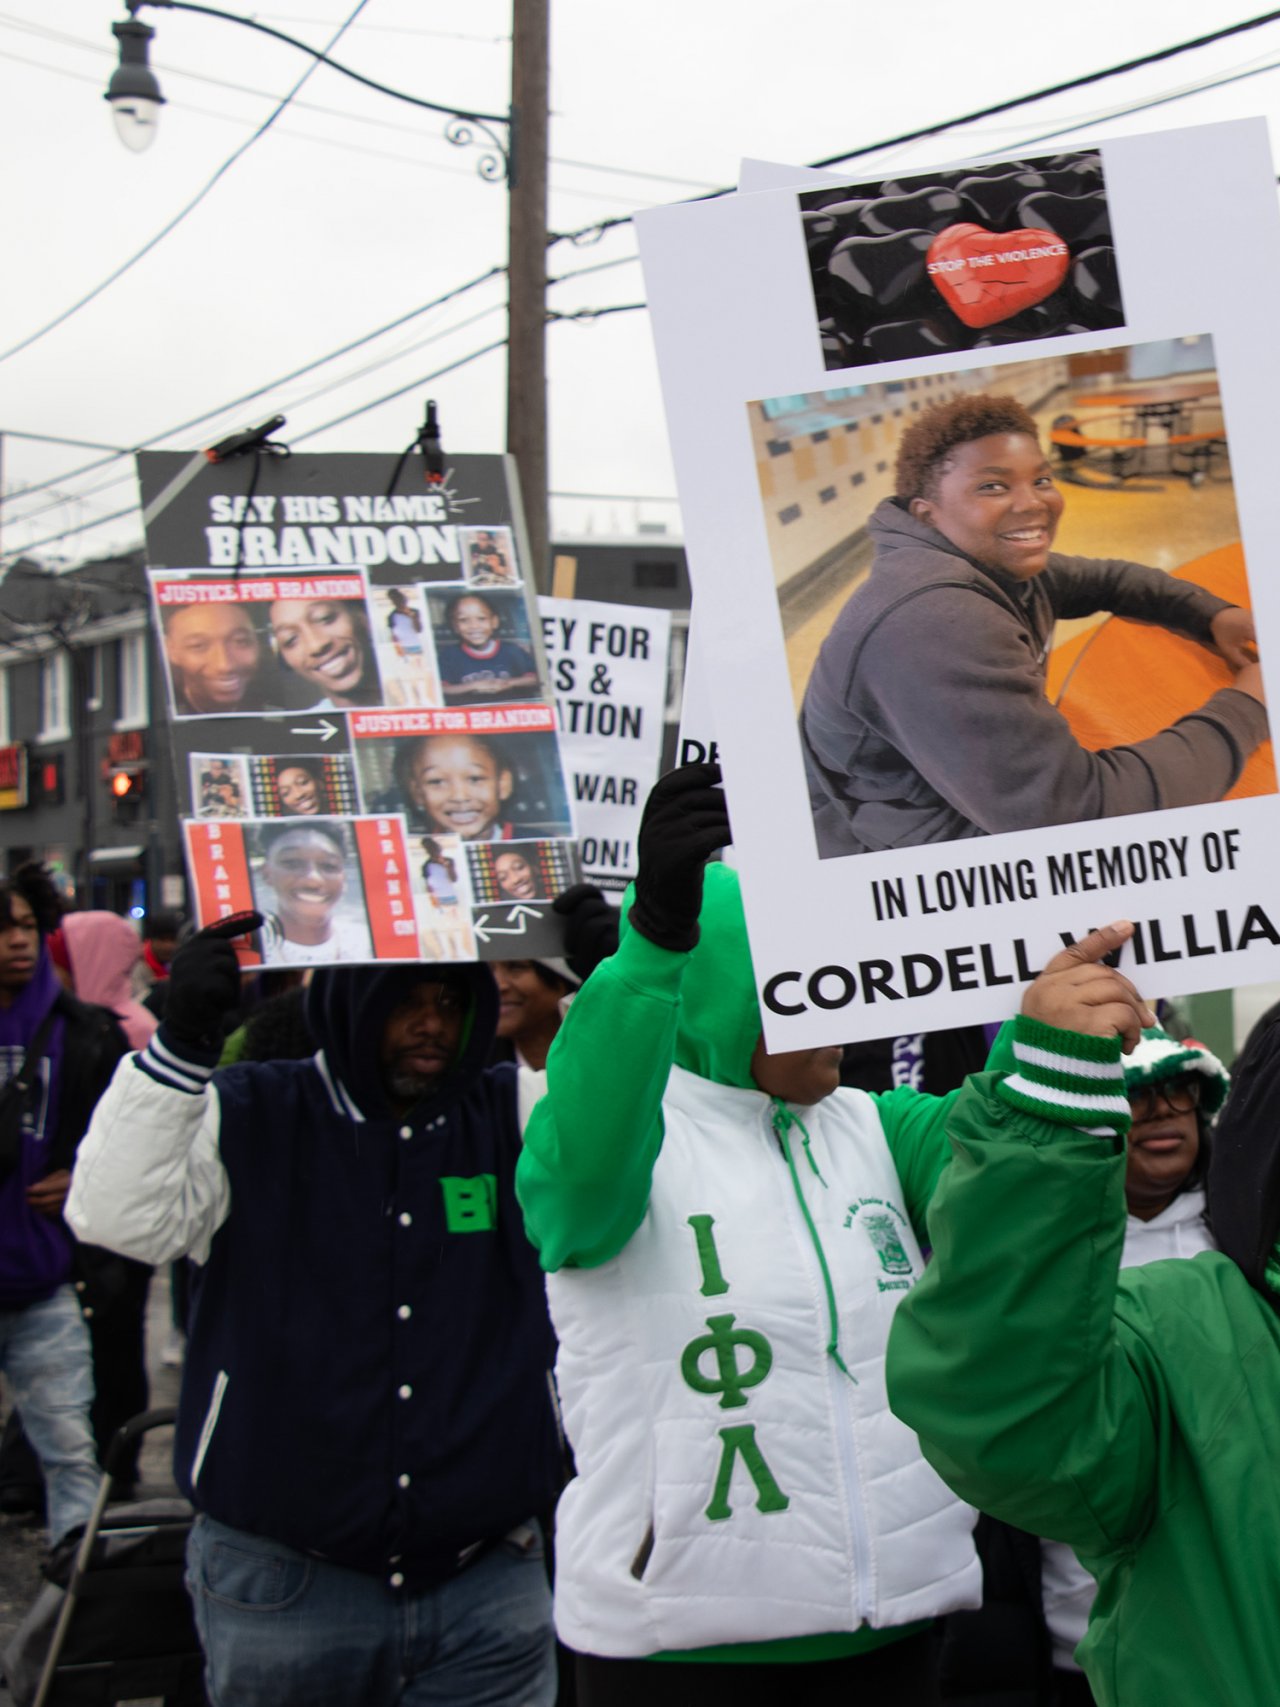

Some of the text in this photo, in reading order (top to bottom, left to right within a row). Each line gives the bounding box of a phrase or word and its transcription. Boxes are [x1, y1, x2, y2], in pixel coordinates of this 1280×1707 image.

[927, 243, 1069, 275] STOP THE VIOLENCE
[210, 494, 448, 523] SAY HIS NAME
[205, 525, 462, 566] BRANDON
[159, 579, 361, 602] JUSTICE FOR BRANDON
[588, 621, 651, 660] FOR
[589, 662, 613, 697] &
[354, 708, 553, 734] JUSTICE FOR BRANDON
[573, 772, 638, 806] WAR
[870, 828, 1242, 922] IN LOVING MEMORY OF
[762, 937, 1045, 1017] CORDELL
[438, 1172, 497, 1234] B
